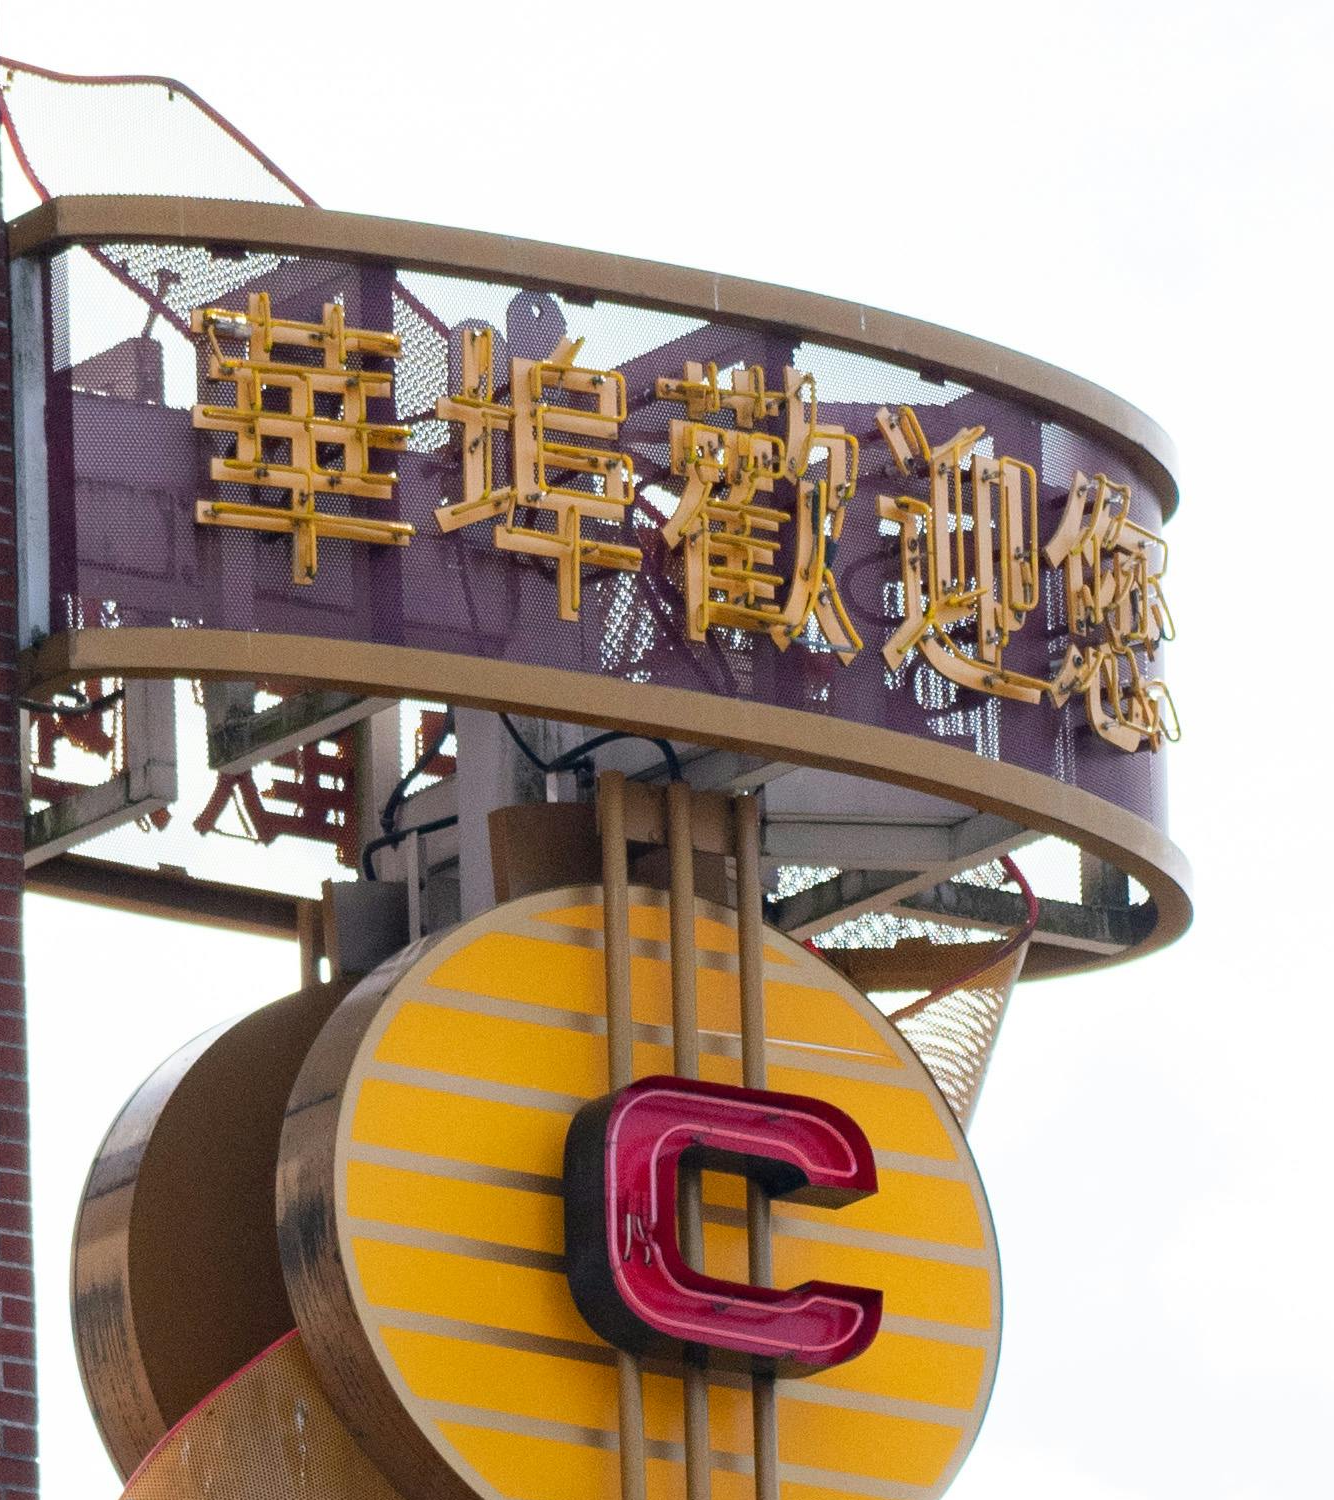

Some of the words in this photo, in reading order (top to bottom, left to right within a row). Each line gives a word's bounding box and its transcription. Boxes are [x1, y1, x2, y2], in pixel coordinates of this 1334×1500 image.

[190, 290, 1181, 753] 華埠歡迎您
